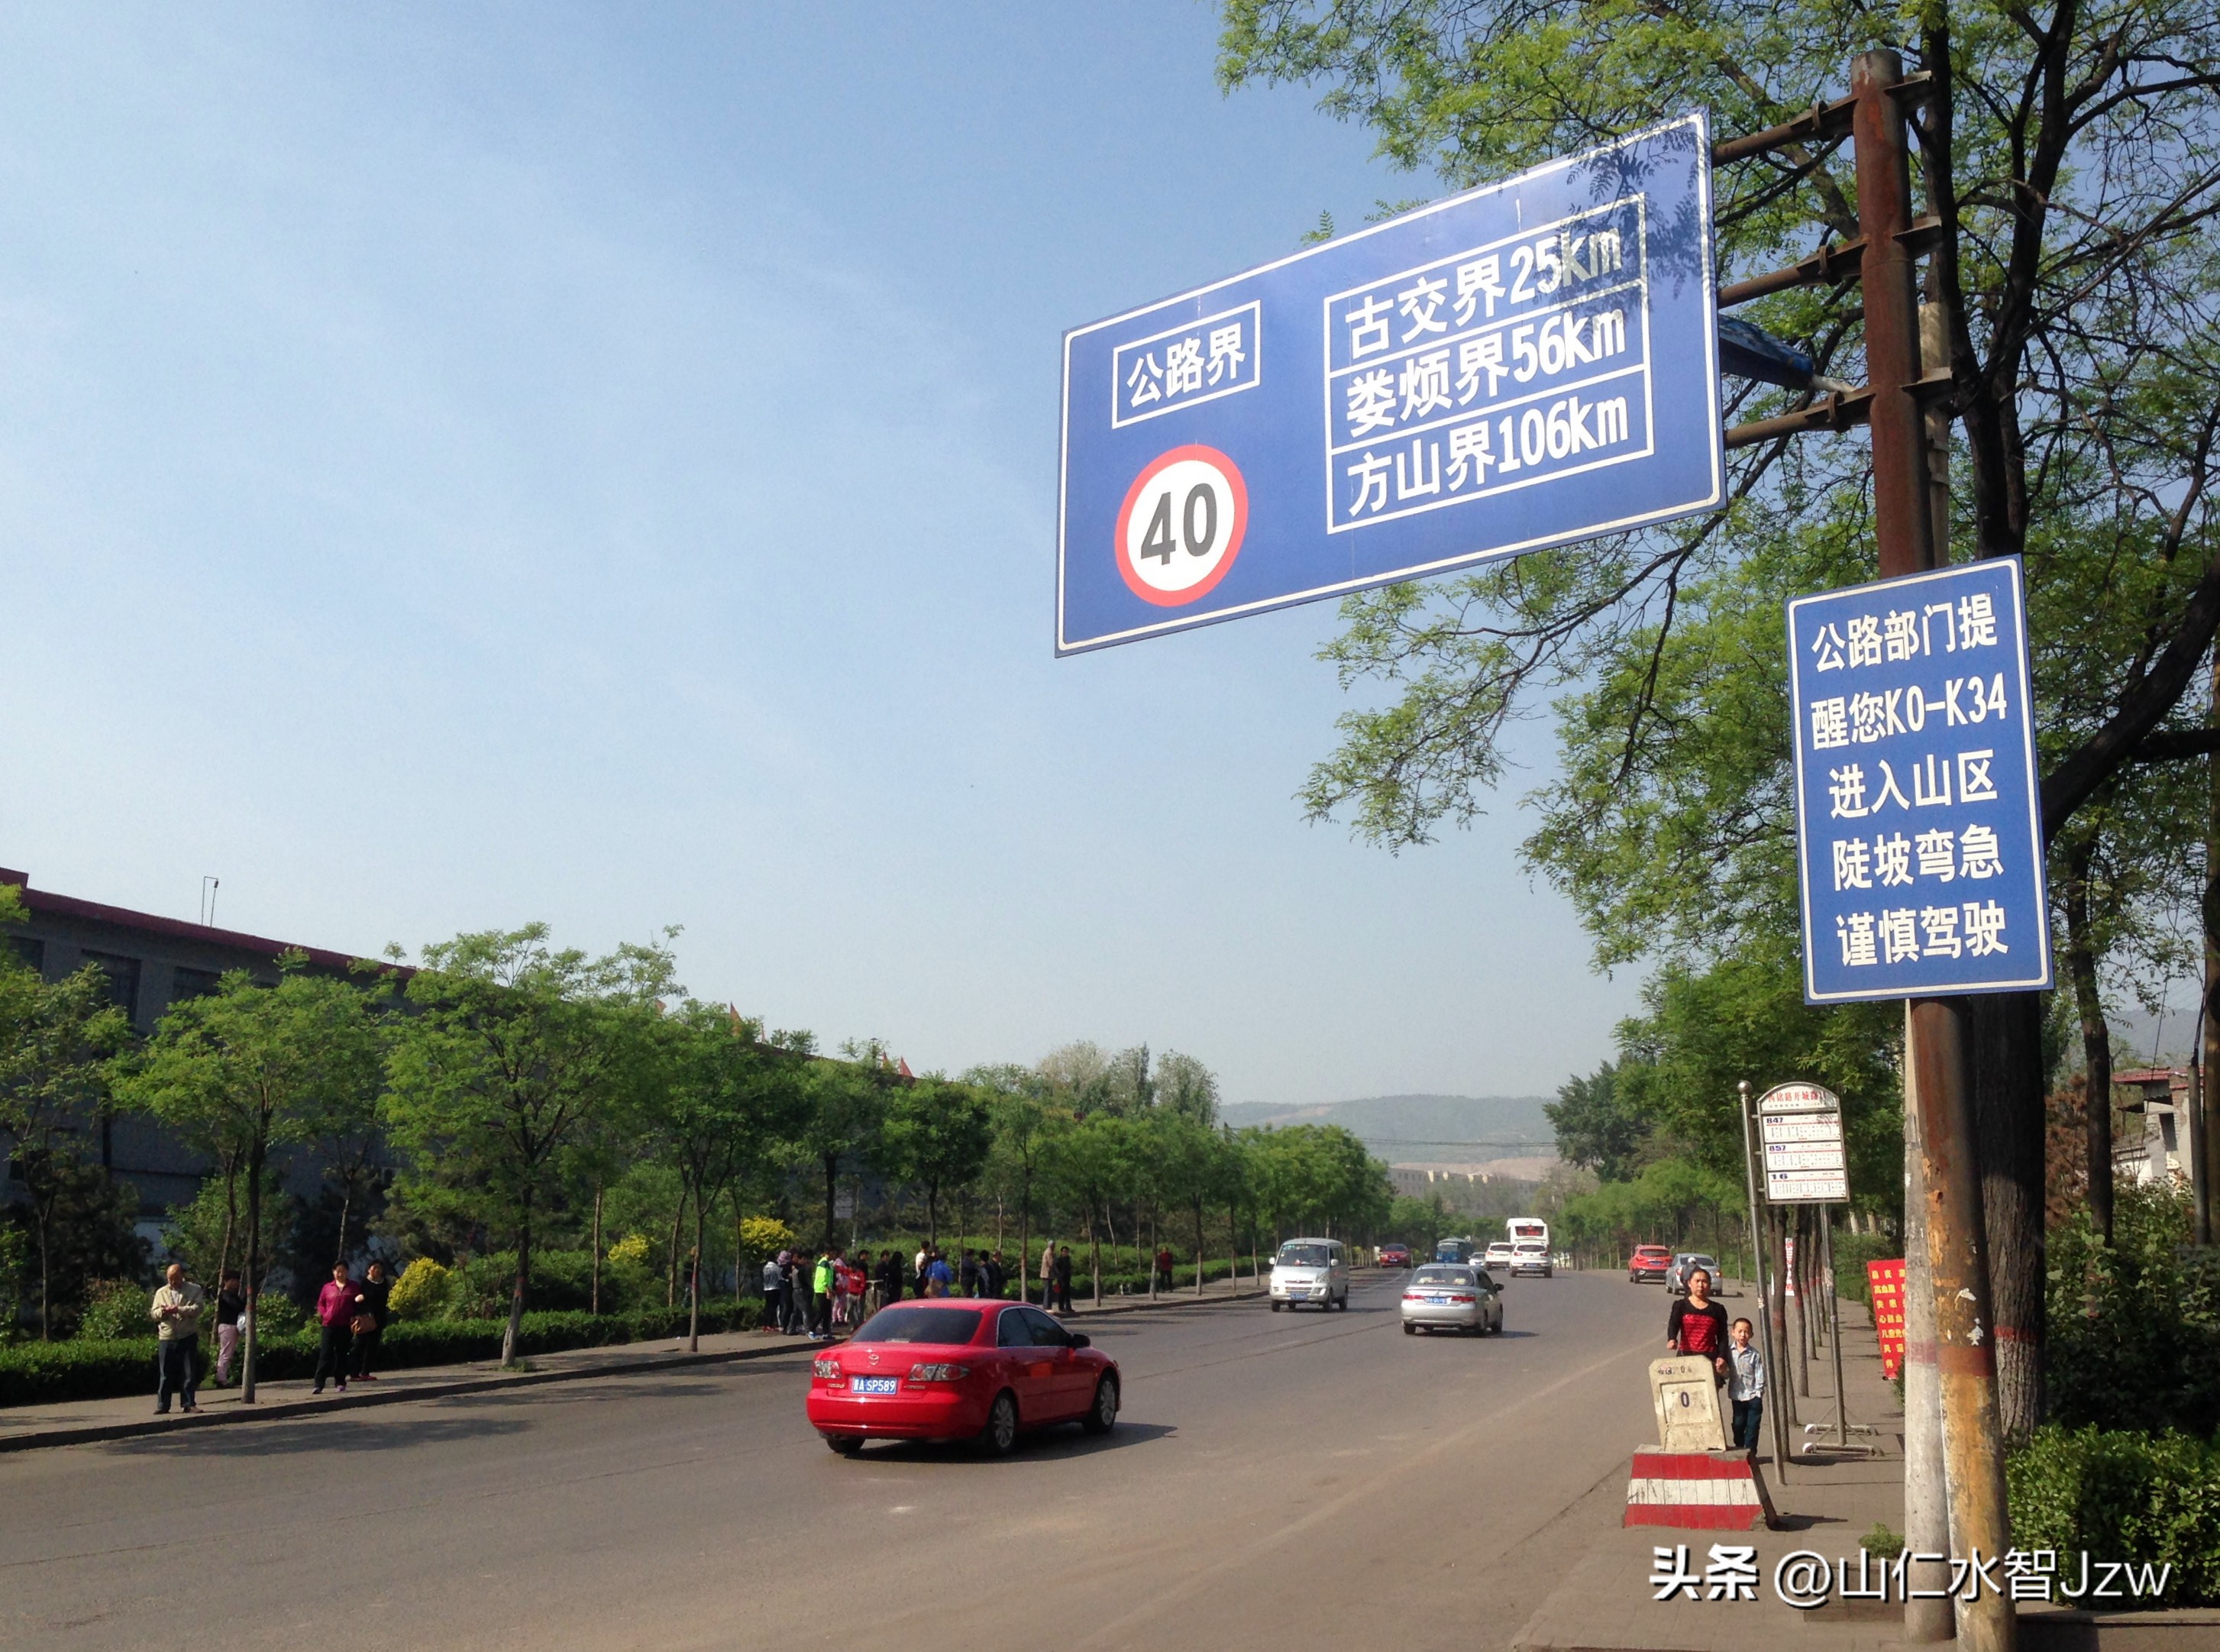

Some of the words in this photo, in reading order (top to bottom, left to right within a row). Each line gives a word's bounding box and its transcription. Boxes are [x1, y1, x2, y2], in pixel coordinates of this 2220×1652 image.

[1345, 227, 1621, 360] 古交界25km
[1126, 322, 1246, 408] 公路界
[1346, 309, 1626, 438] 娄烦界56km
[1347, 396, 1629, 517] 方山界106km
[1140, 482, 1217, 566] 40
[1811, 592, 1998, 673] 公路部门提
[1828, 748, 1998, 820] 进入山区
[1832, 823, 2005, 891] 陡坡弯急
[1836, 899, 2008, 967] 谨慎驾驶
